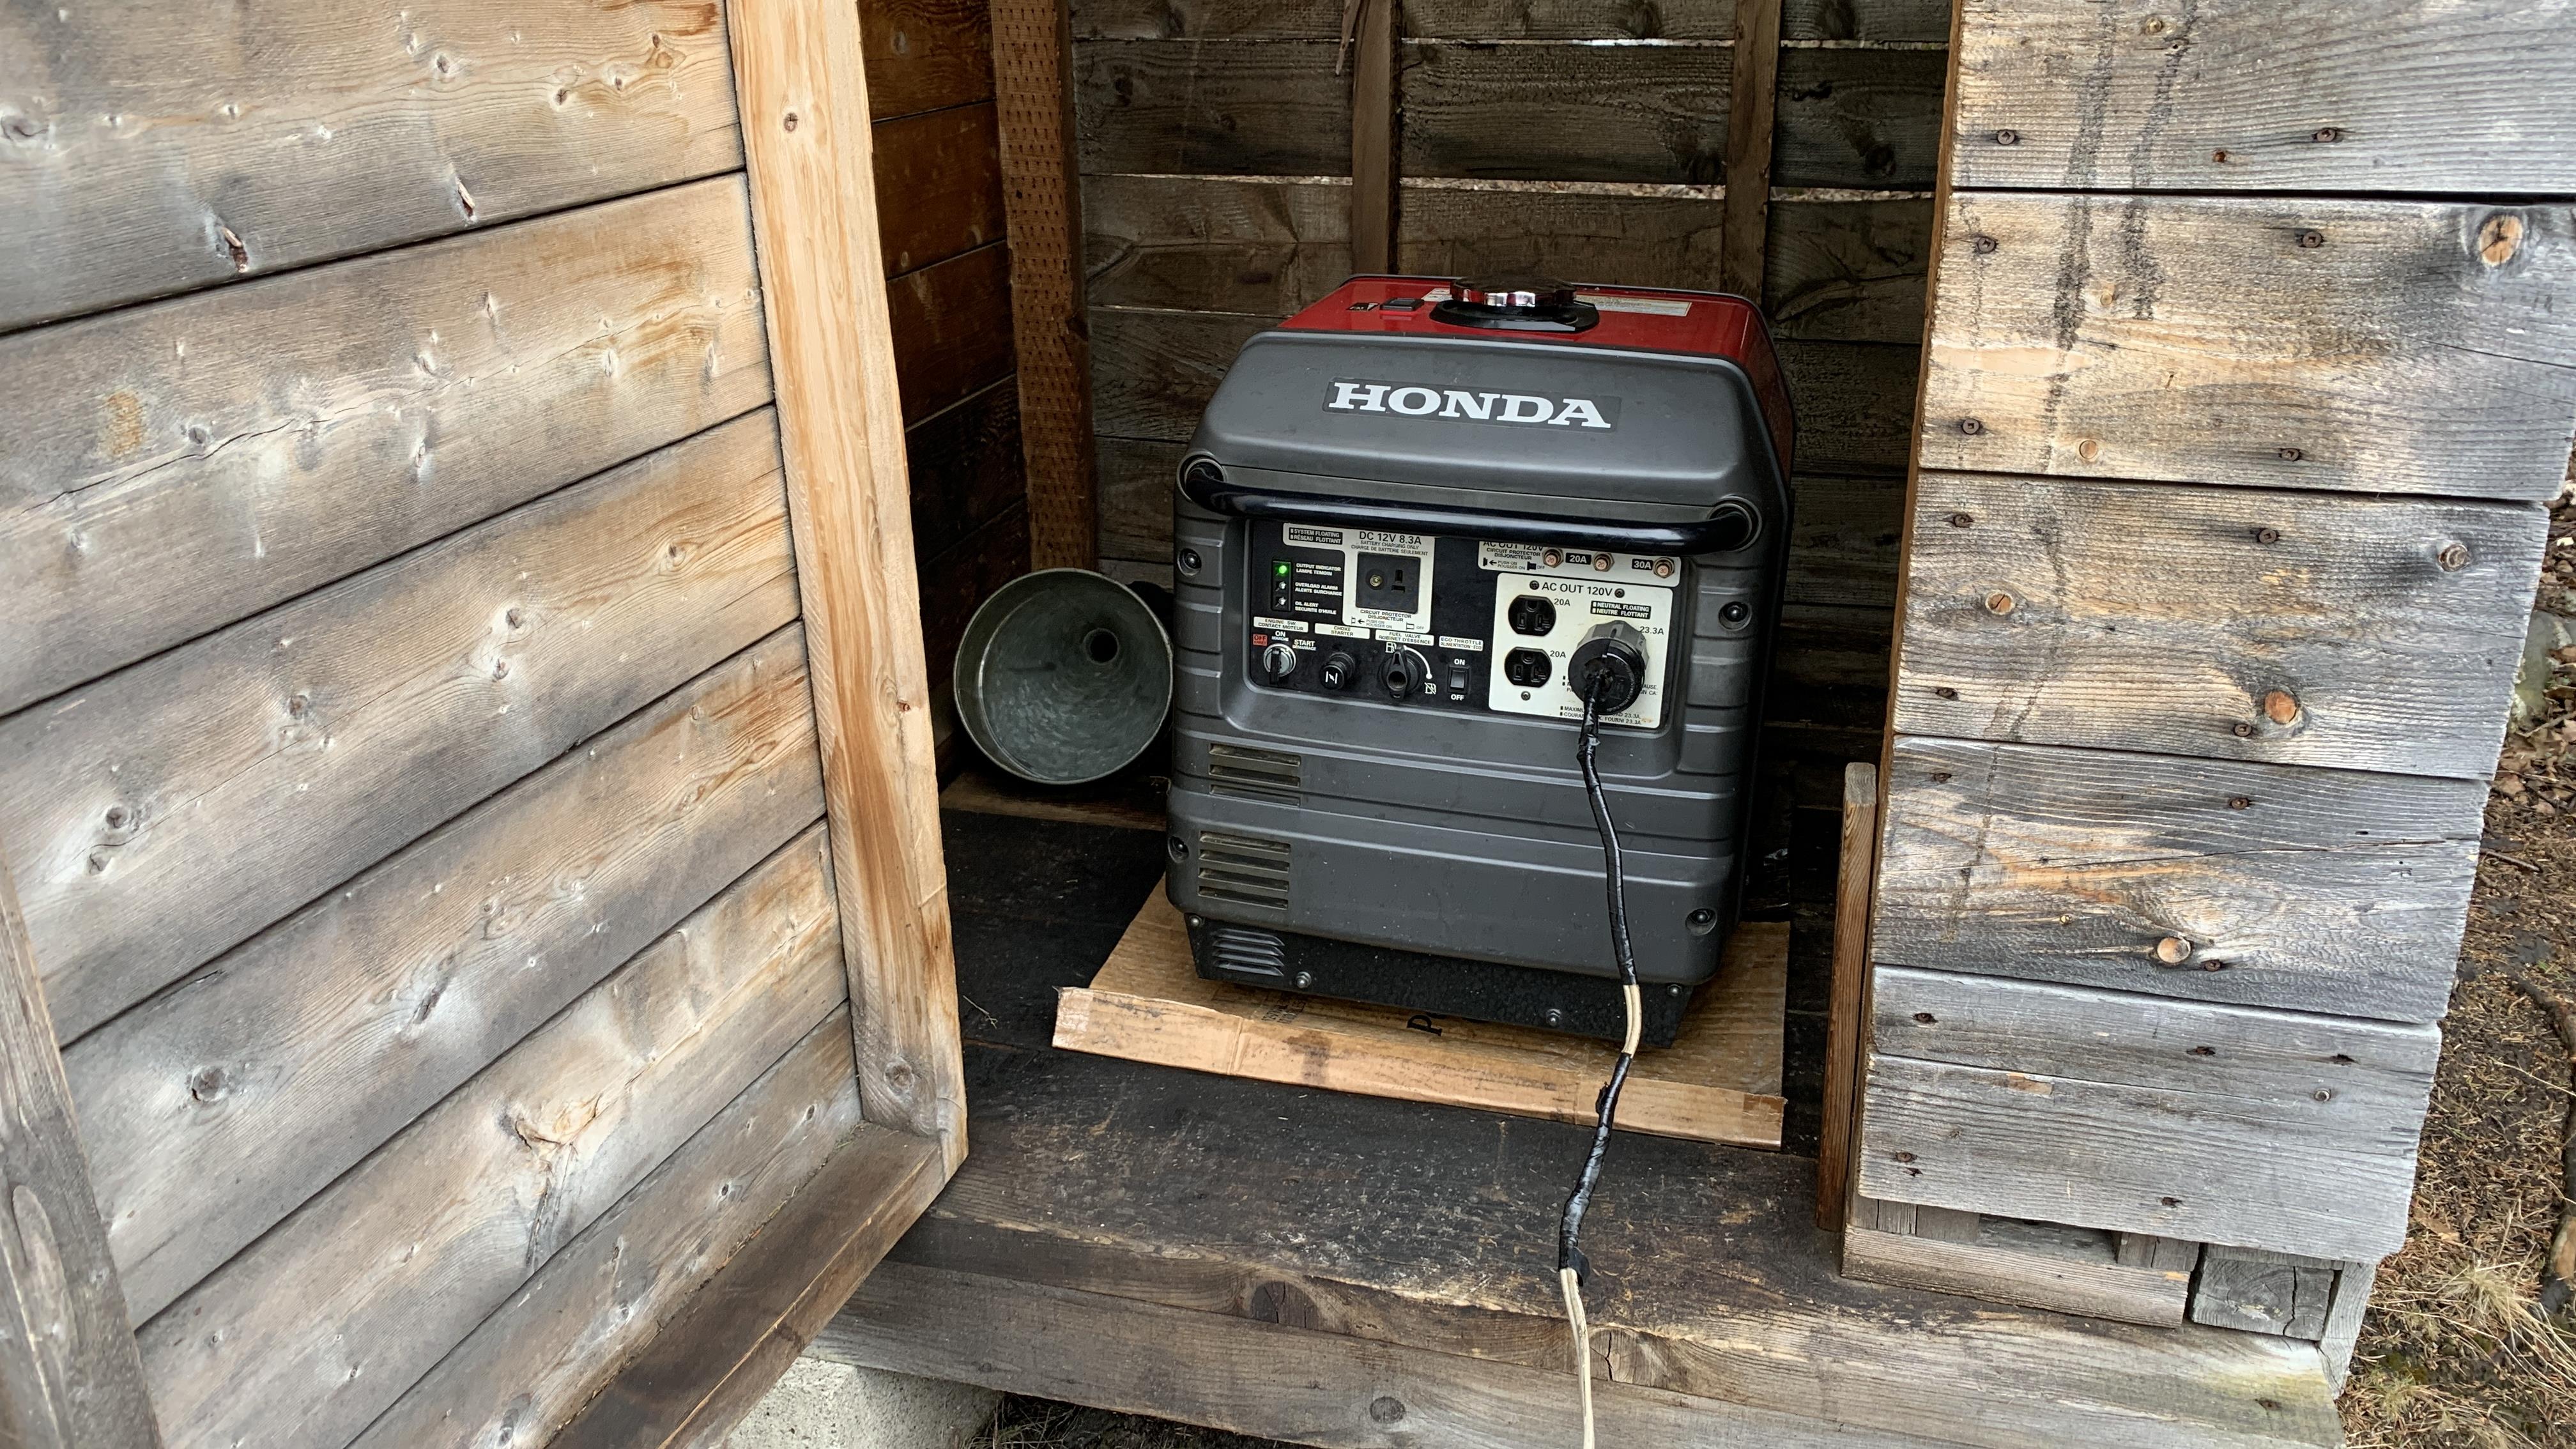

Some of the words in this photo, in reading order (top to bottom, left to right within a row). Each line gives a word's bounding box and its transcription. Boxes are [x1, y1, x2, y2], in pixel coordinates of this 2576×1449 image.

[1328, 381, 1611, 429] HONDA
[1359, 531, 1373, 539] DC
[1377, 533, 1396, 542] 12V
[1399, 535, 1421, 544] 8.3A
[1494, 552, 1531, 560] DISJONCTEUR
[1568, 554, 1587, 564] 20A
[1633, 560, 1652, 569] 30A
[1542, 581, 1556, 590] AC
[1560, 583, 1584, 593] OUT
[1586, 586, 1613, 596] 120V
[1639, 625, 1664, 635] 23.3A
[1549, 649, 1566, 658] 20A
